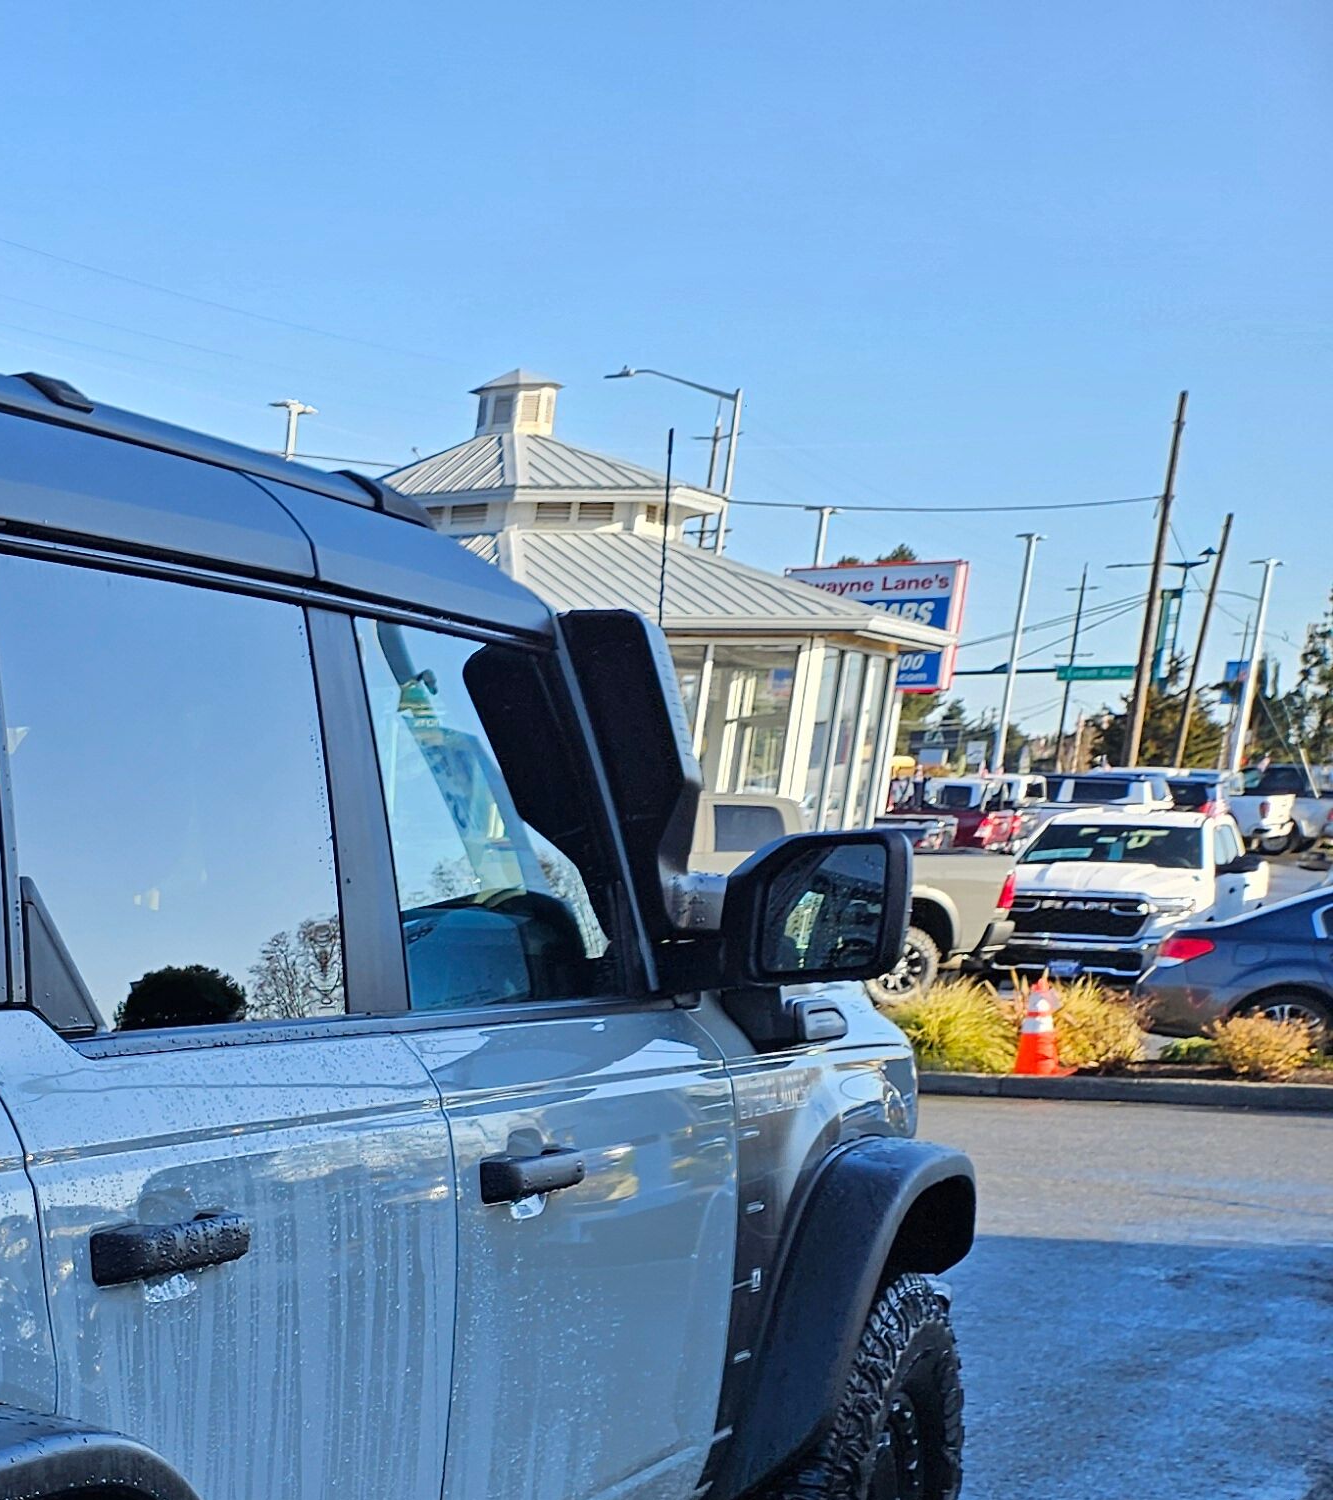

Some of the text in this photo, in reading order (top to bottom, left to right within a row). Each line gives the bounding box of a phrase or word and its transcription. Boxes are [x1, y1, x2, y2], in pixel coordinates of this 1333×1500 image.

[798, 574, 950, 596] wayne Lane's
[898, 654, 926, 670] 00
[1041, 899, 1110, 911] RAM
